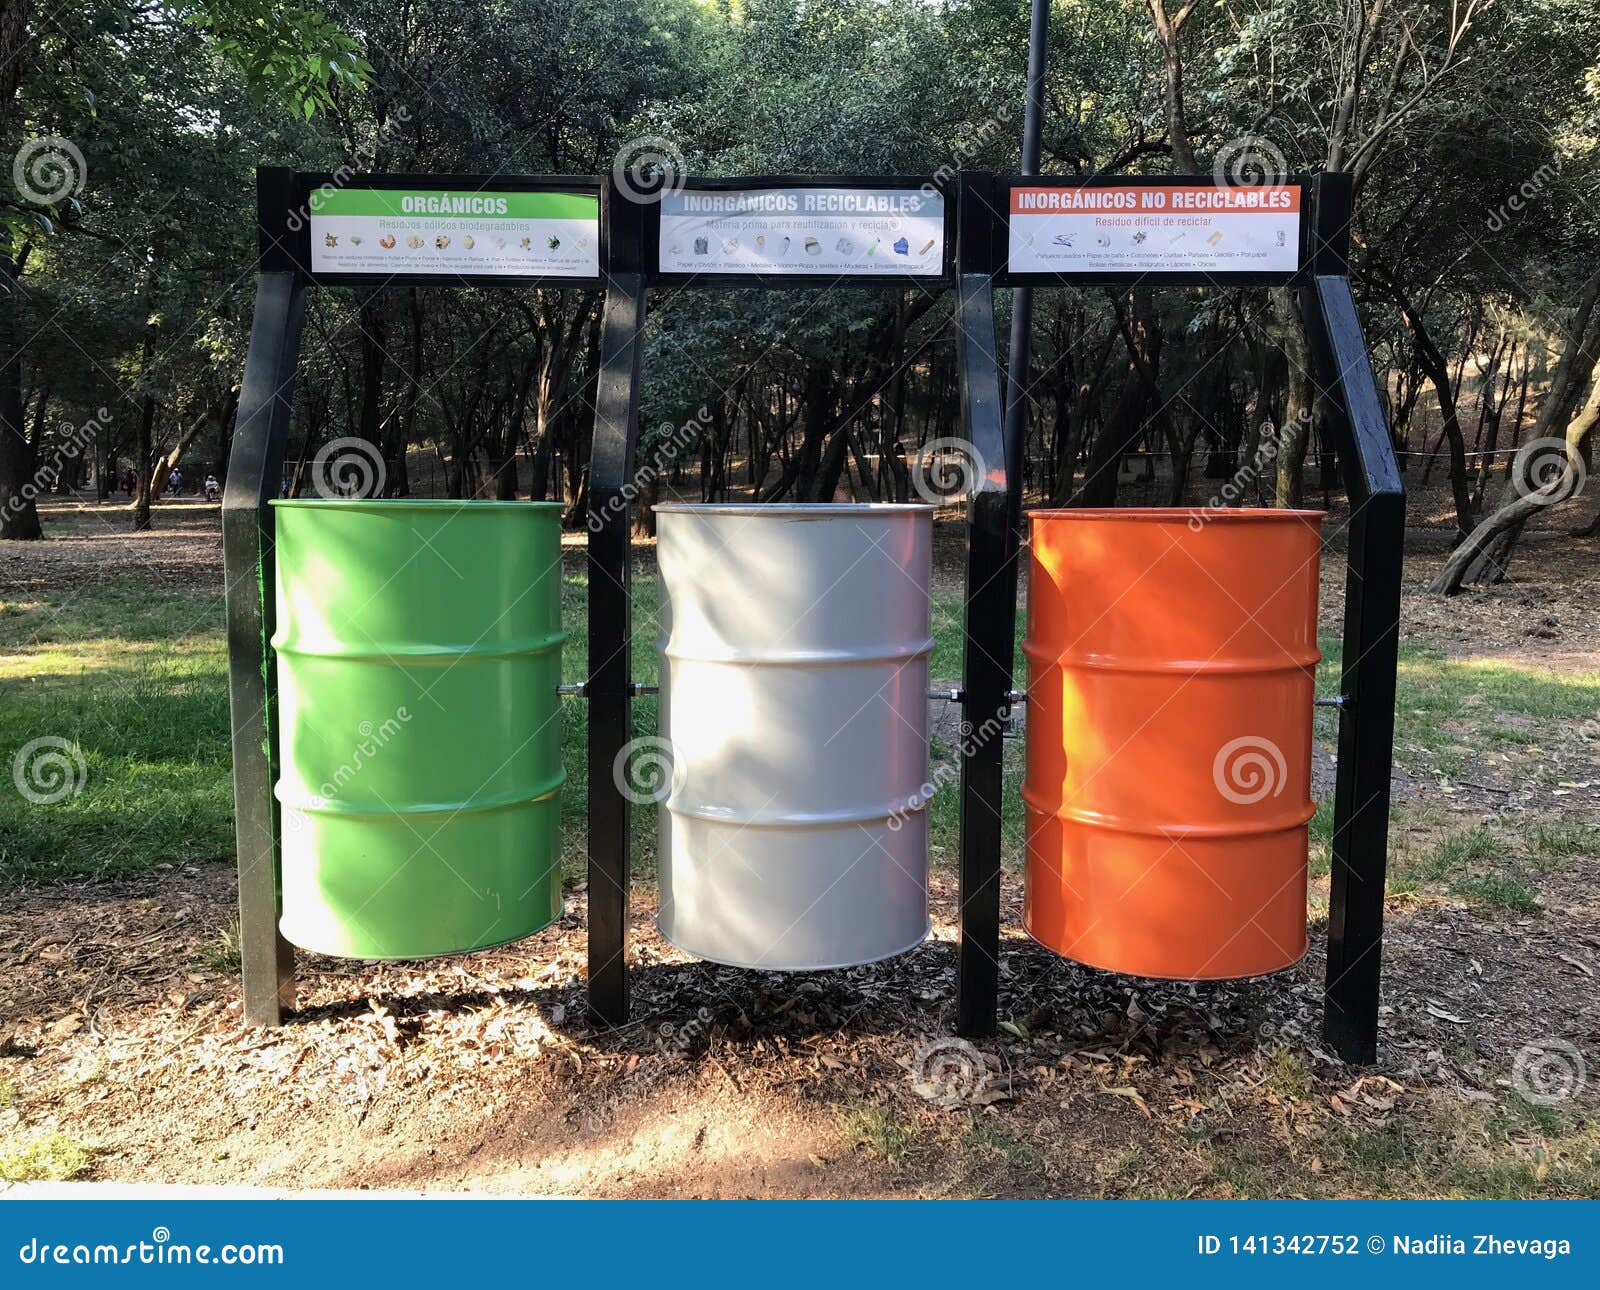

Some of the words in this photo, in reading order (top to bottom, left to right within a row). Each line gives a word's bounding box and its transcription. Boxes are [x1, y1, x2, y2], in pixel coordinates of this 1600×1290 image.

[401, 193, 508, 214] ORGÁNICOS
[684, 192, 798, 212] INORGÁNICOS
[805, 194, 921, 212] RECICLABLES
[1018, 189, 1137, 209] INORGÁNICOS
[1141, 192, 1166, 209] NO
[1172, 191, 1291, 208] RECICLABLES
[460, 221, 530, 232] biodegradables
[742, 221, 768, 231] prima
[771, 221, 791, 231] para
[1095, 217, 1132, 226] Residuo
[1163, 217, 1174, 226] de
[1177, 217, 1212, 226] reciclar
